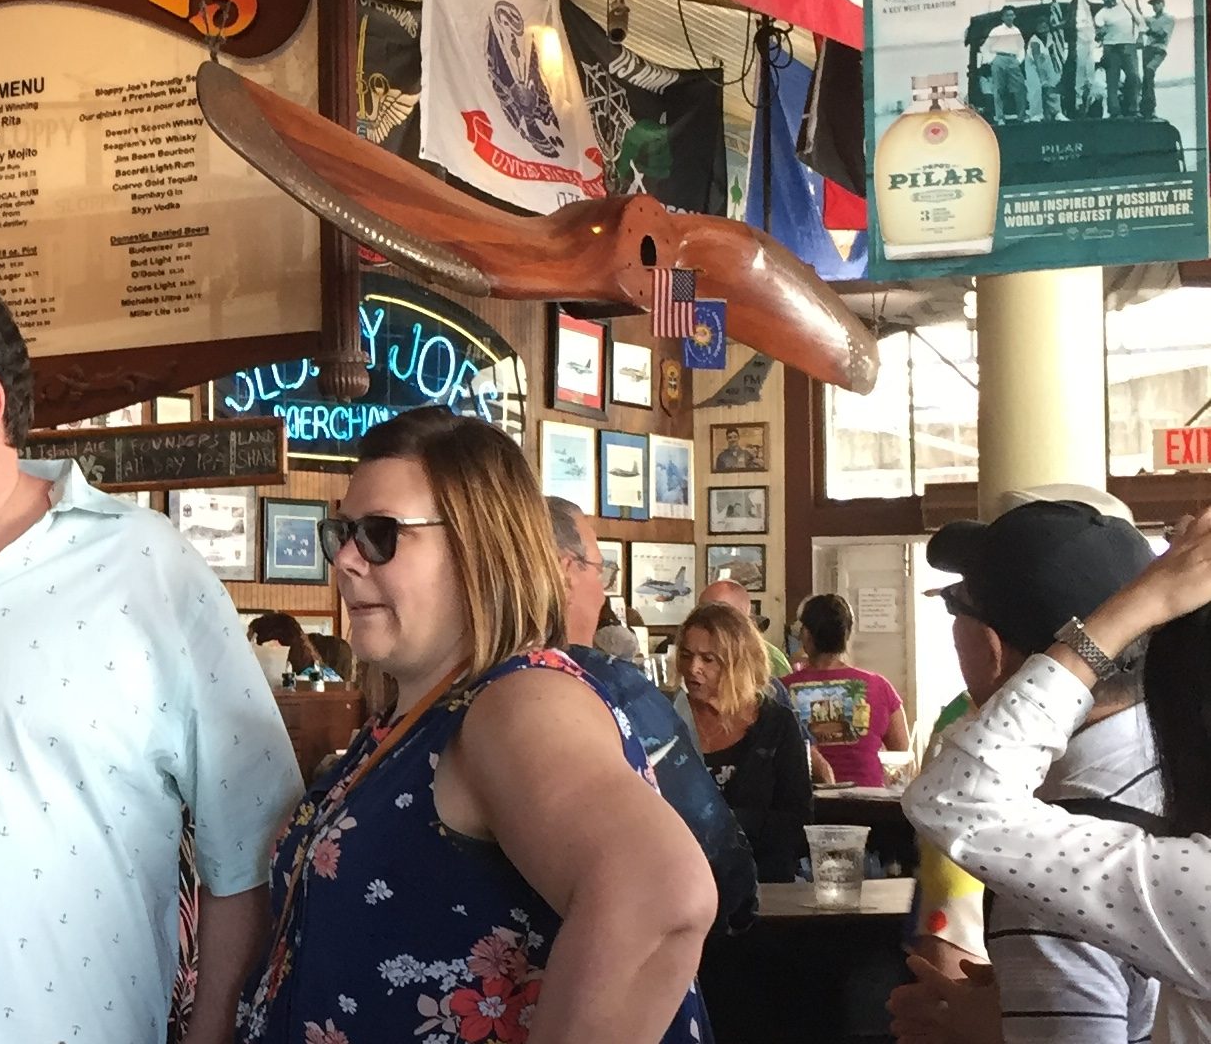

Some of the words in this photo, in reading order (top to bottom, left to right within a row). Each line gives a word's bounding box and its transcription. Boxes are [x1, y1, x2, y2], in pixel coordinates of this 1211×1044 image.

[95, 86, 124, 96] Sloppy
[126, 82, 147, 92] Joe's
[150, 77, 183, 87] Proudly
[129, 90, 166, 101] Premium
[169, 87, 186, 95] Well
[6, 101, 39, 112] Winning
[79, 114, 95, 122] Our
[96, 110, 122, 120] drinks
[124, 107, 144, 115] have
[153, 102, 174, 112] pour
[2, 116, 21, 127] Rita
[106, 127, 138, 137] Dewar's
[173, 117, 204, 128] Whisky
[104, 140, 146, 151] Seagram's
[166, 134, 197, 143] Whisky
[1041, 143, 1083, 154] PILAR
[8, 148, 38, 160] Mojito
[132, 152, 155, 161] Beam
[158, 147, 194, 157] Bourbon
[115, 166, 148, 177] Bacardi
[150, 163, 173, 174] Light
[175, 161, 195, 169] Rum
[492, 149, 540, 179] UNITED
[113, 182, 142, 191] Cuervo
[145, 178, 165, 188] Gold
[168, 174, 198, 185] Tequila
[888, 167, 987, 190] PILAR
[131, 191, 165, 201] Bombay
[1004, 202, 1012, 214] A
[1015, 201, 1039, 213] RUM
[1043, 197, 1095, 212] INSPIRED
[1099, 194, 1113, 207] BY
[1117, 190, 1169, 206] POSSIBLY
[1172, 188, 1193, 201] THE
[154, 201, 180, 212] Vodka
[1004, 212, 1055, 228] WORLD'S
[1058, 208, 1112, 224] GREATEST
[1116, 203, 1194, 220] ADVENTURER.
[150, 256, 171, 266] Light
[154, 281, 176, 291] Light
[238, 428, 277, 446] LAND
